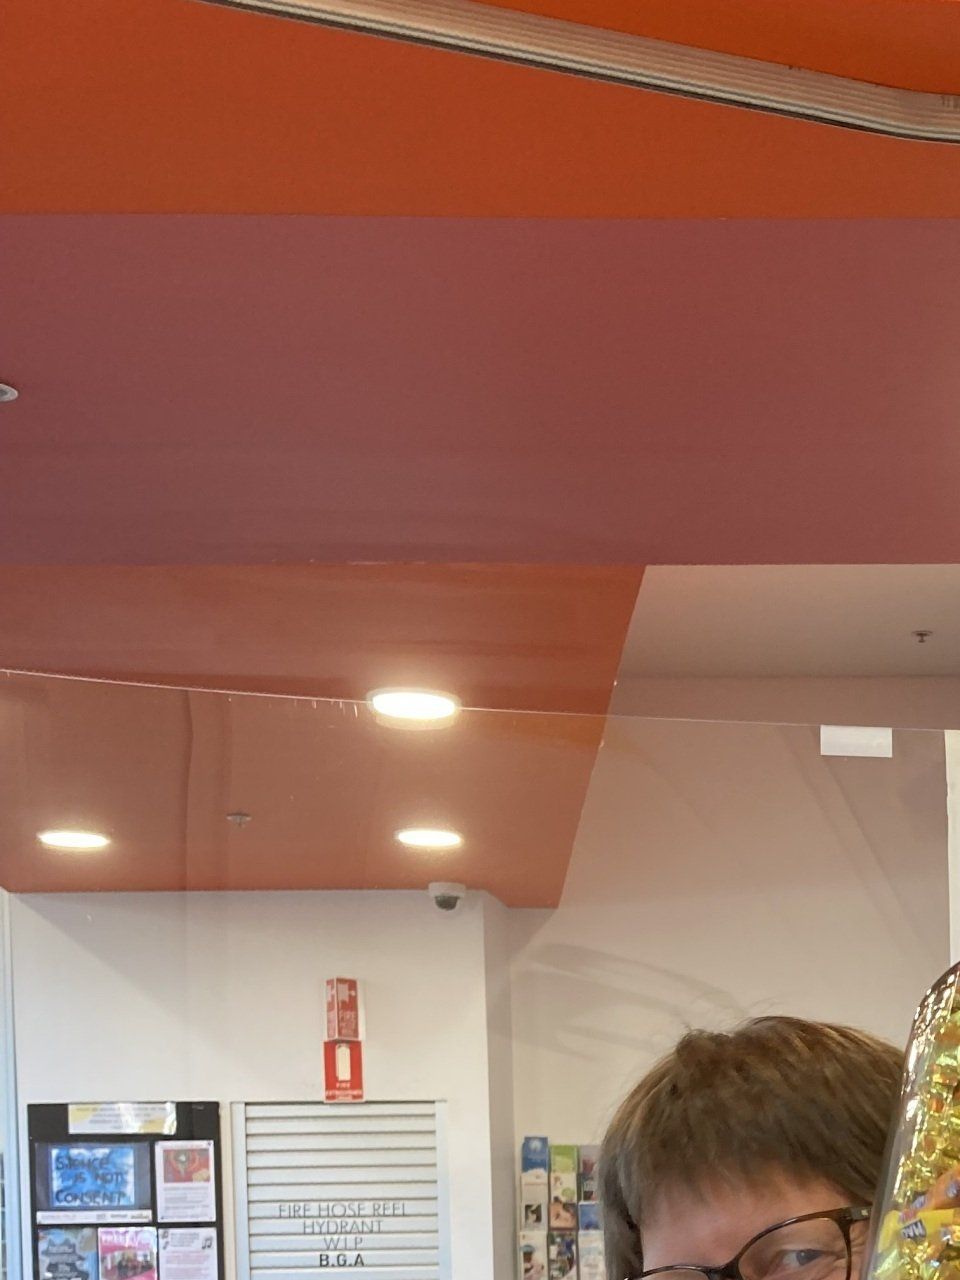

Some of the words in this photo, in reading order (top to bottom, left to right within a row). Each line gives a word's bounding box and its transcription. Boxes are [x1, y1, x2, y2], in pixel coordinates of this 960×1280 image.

[278, 1203, 311, 1219] FIRE
[318, 1203, 365, 1217] HOSE
[373, 1202, 406, 1217] REEL
[303, 1220, 384, 1234] HYDRANT
[319, 1253, 365, 1268] B.G.A
